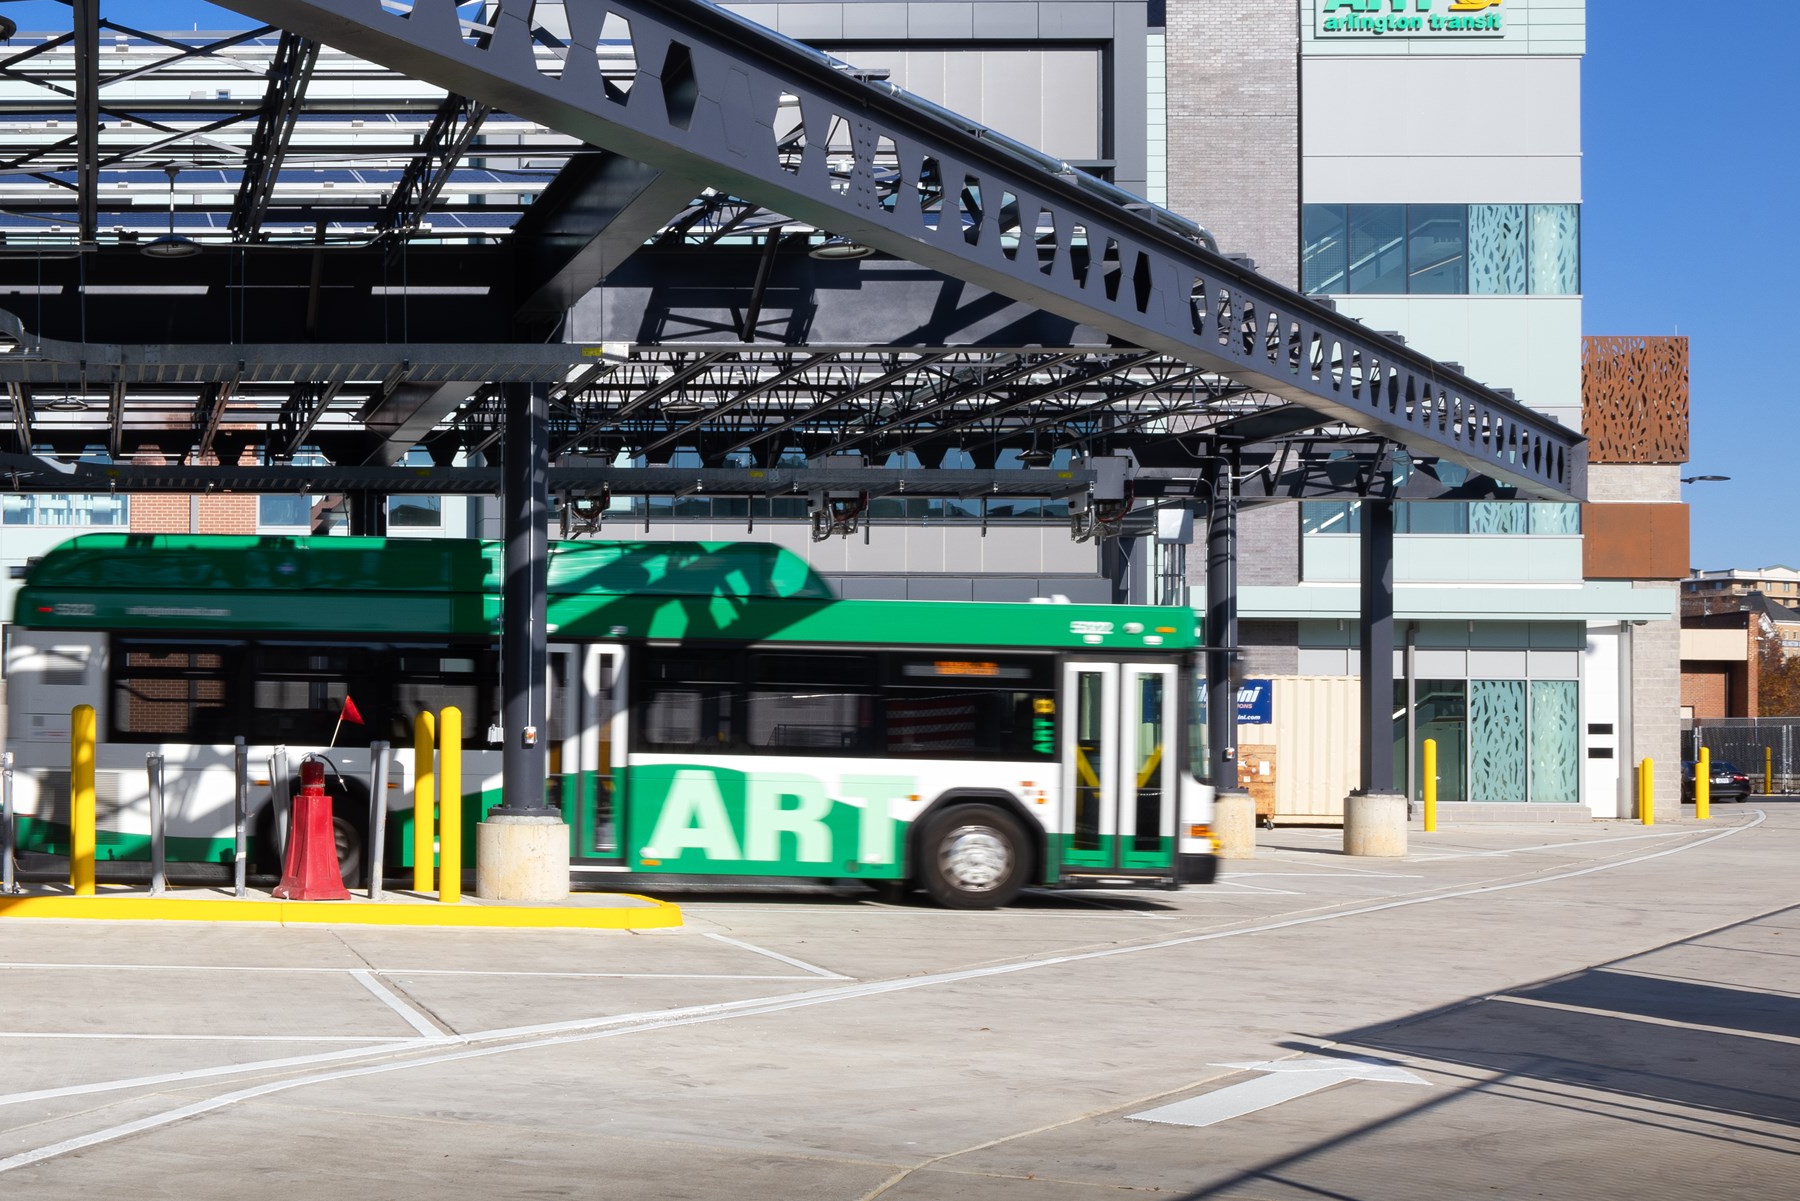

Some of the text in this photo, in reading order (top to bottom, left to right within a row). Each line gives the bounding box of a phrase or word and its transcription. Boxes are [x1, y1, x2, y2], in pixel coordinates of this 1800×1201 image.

[1323, 13, 1503, 35] arlington transit
[1236, 686, 1263, 703] ini
[645, 768, 918, 865] ART
